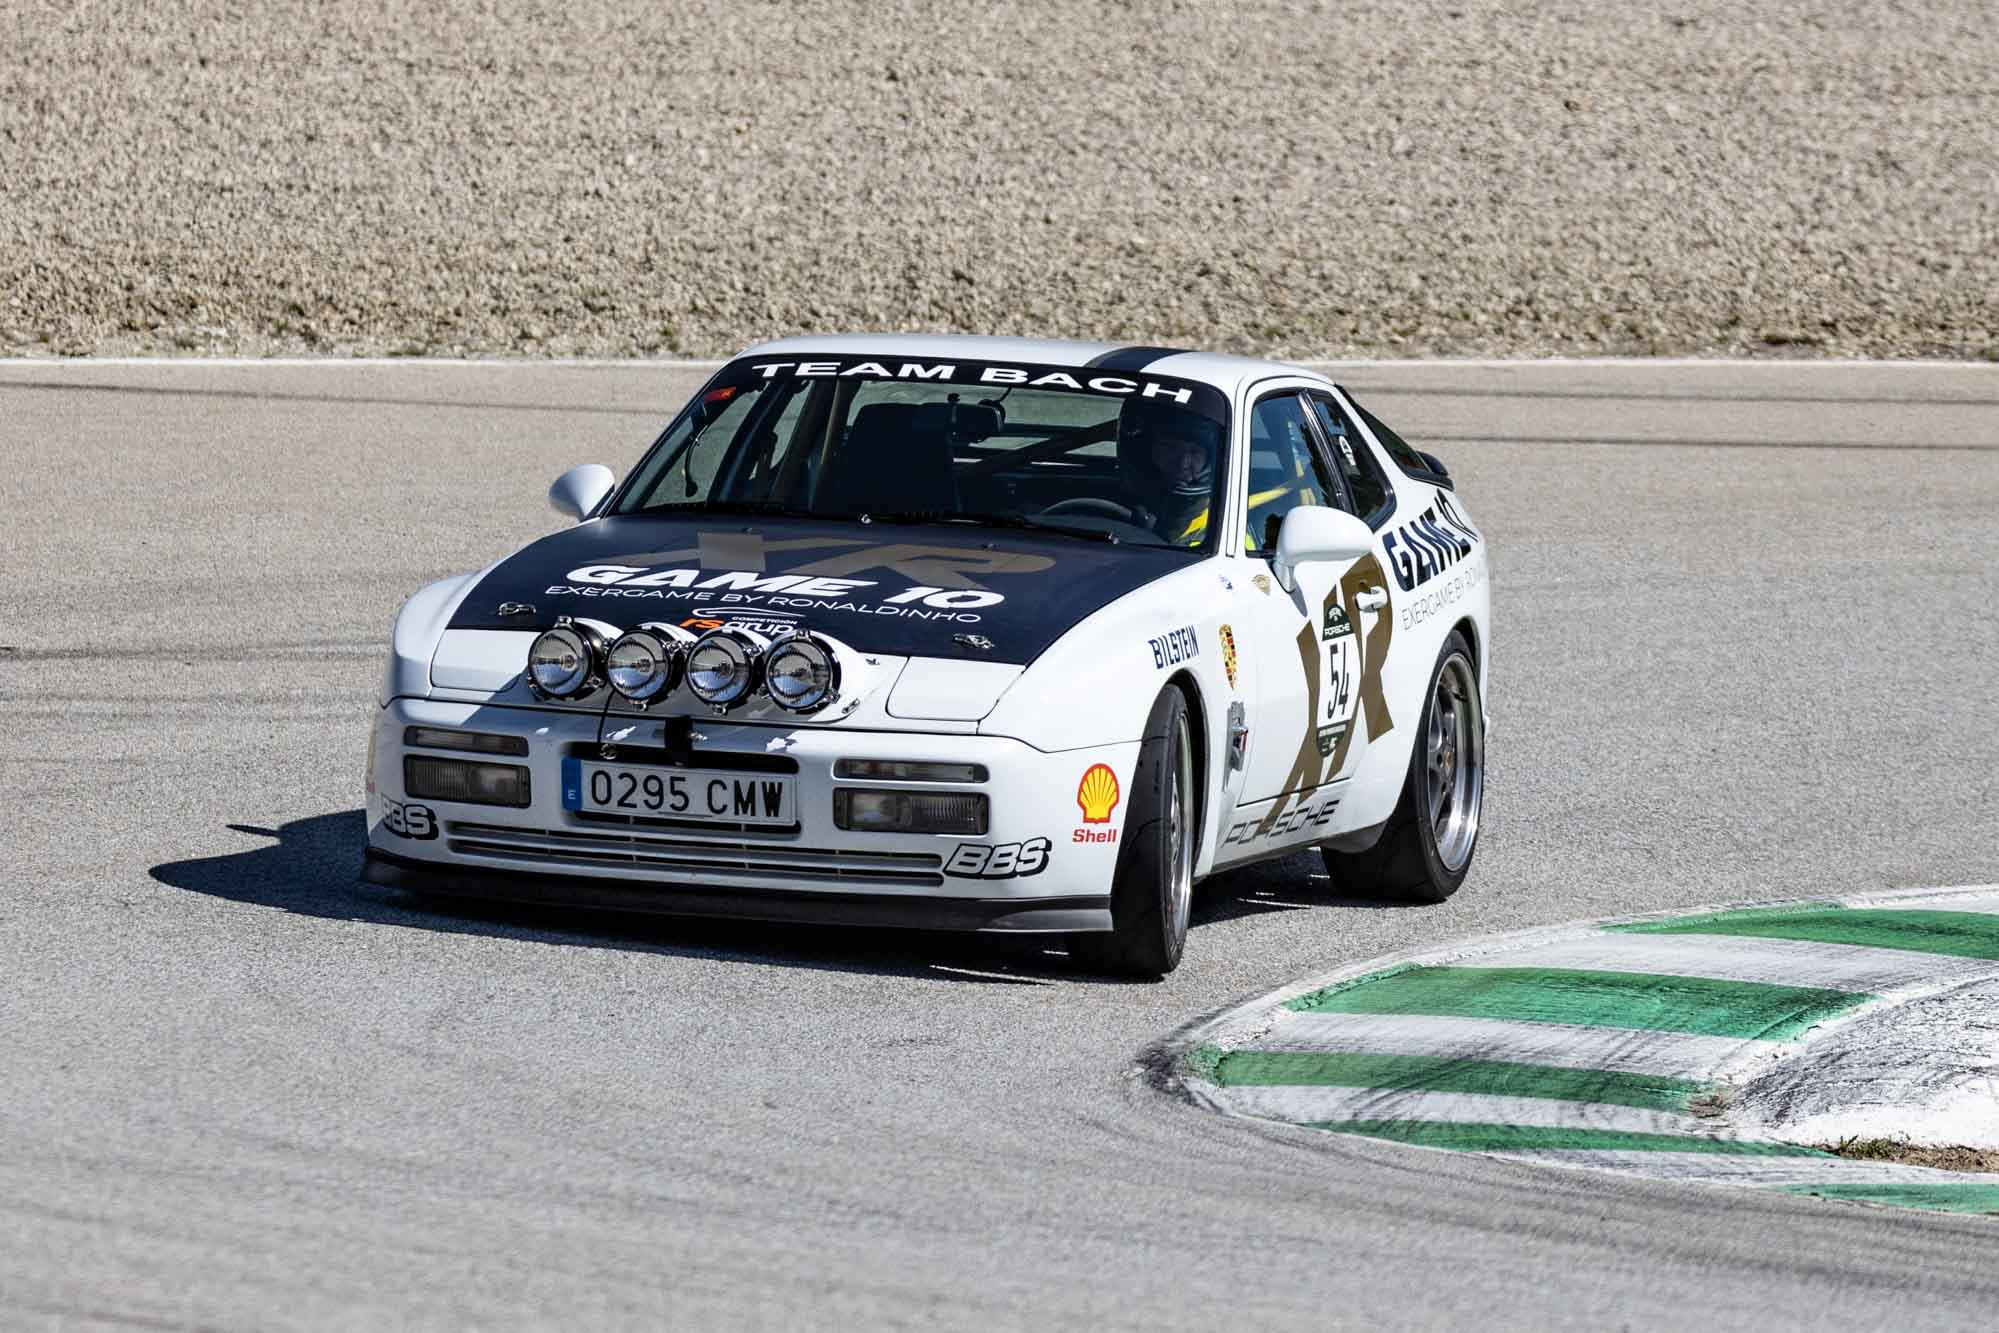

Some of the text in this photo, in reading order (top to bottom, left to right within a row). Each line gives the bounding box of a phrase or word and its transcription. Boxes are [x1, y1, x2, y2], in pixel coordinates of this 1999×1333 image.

[751, 361, 1192, 404] TEAM BACH
[1382, 506, 1472, 592] GAME
[544, 585, 983, 624] EXERGAME BY RONALDINHO
[565, 564, 1006, 609] GAME 10
[1147, 624, 1200, 670] BILSTEIN
[1327, 640, 1350, 719] 54
[591, 769, 783, 818] 0295 CMW
[943, 836, 1053, 881] BBS
[1072, 828, 1118, 844] Shell
